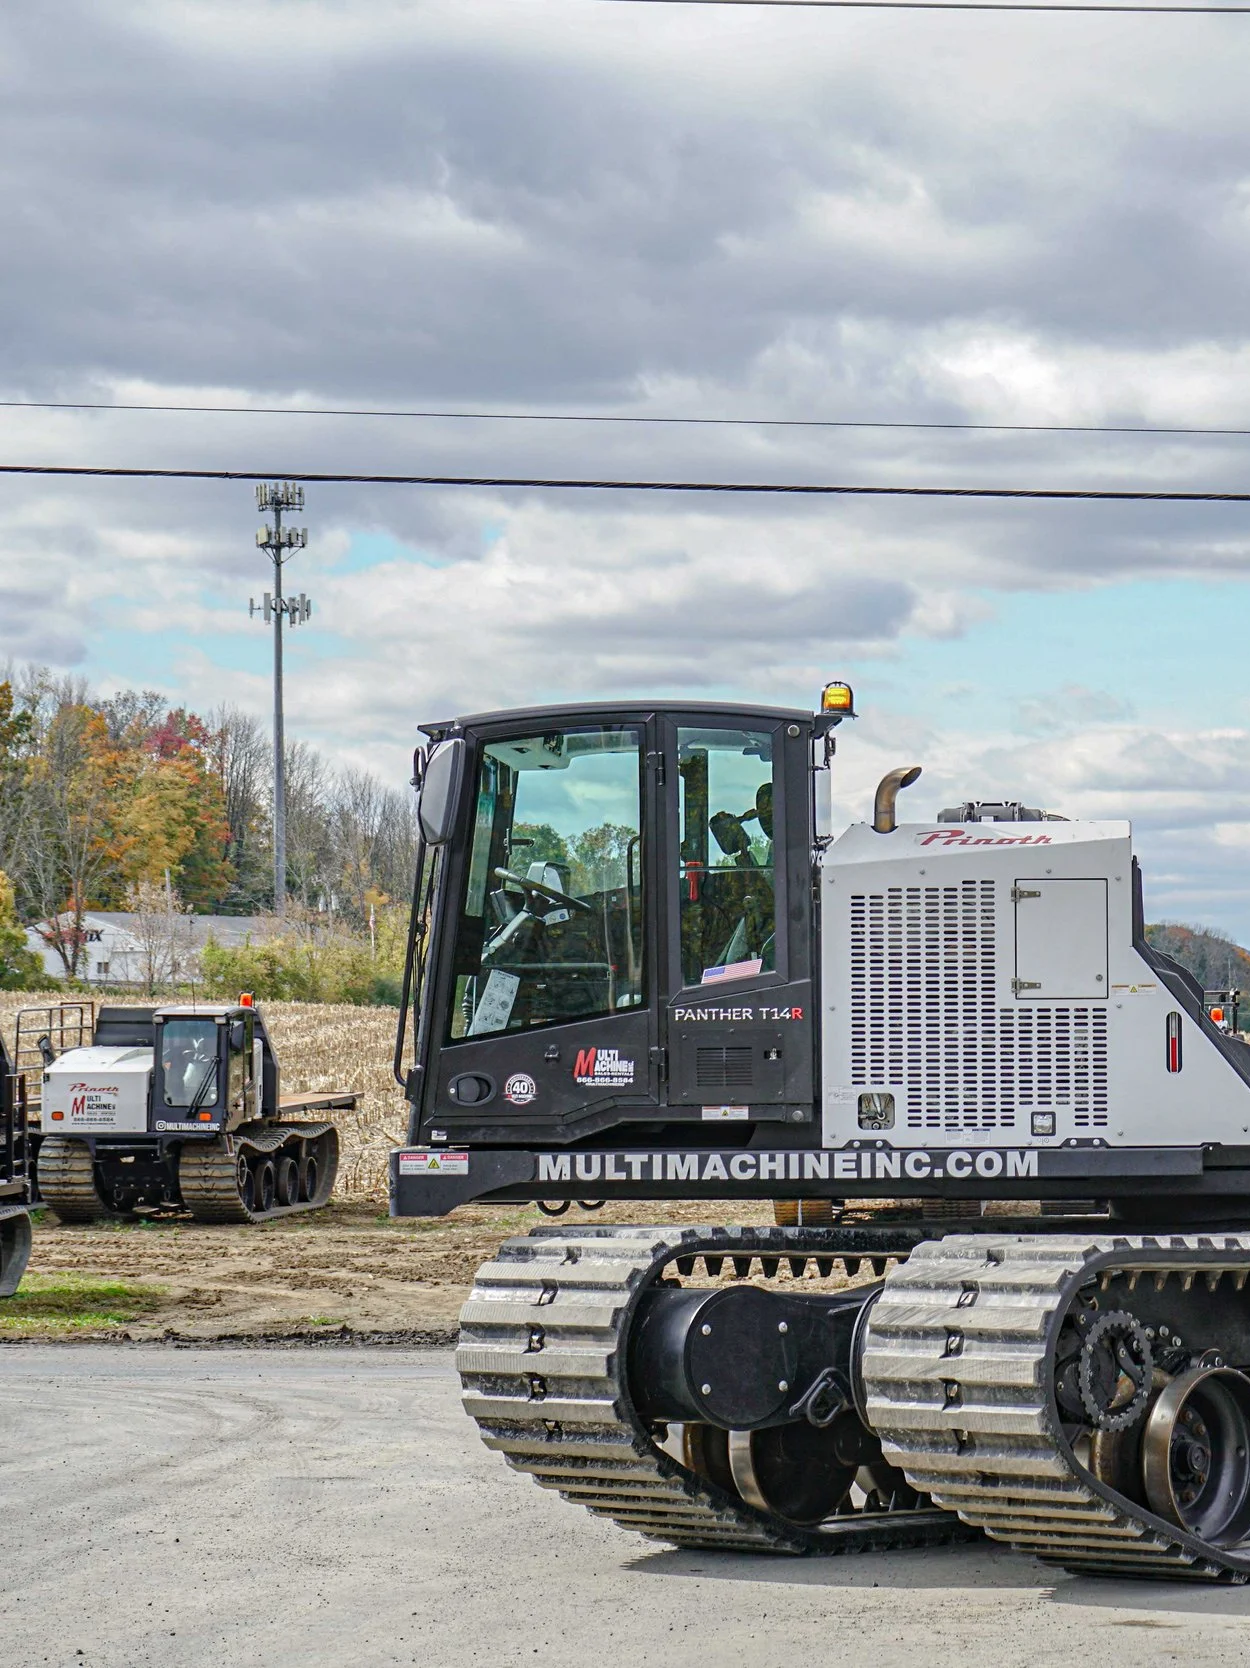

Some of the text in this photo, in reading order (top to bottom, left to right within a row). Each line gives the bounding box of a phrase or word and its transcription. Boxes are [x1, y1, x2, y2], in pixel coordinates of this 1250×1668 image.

[916, 829, 1052, 846] Prinoth
[674, 1007, 803, 1021] PANTHER T14R
[69, 1082, 119, 1093] Prinoth
[512, 1081, 528, 1094] 40
[166, 1123, 220, 1131] MULTIMACHINEINC
[538, 1151, 1039, 1181] MULTIMACHINEINC.COM
